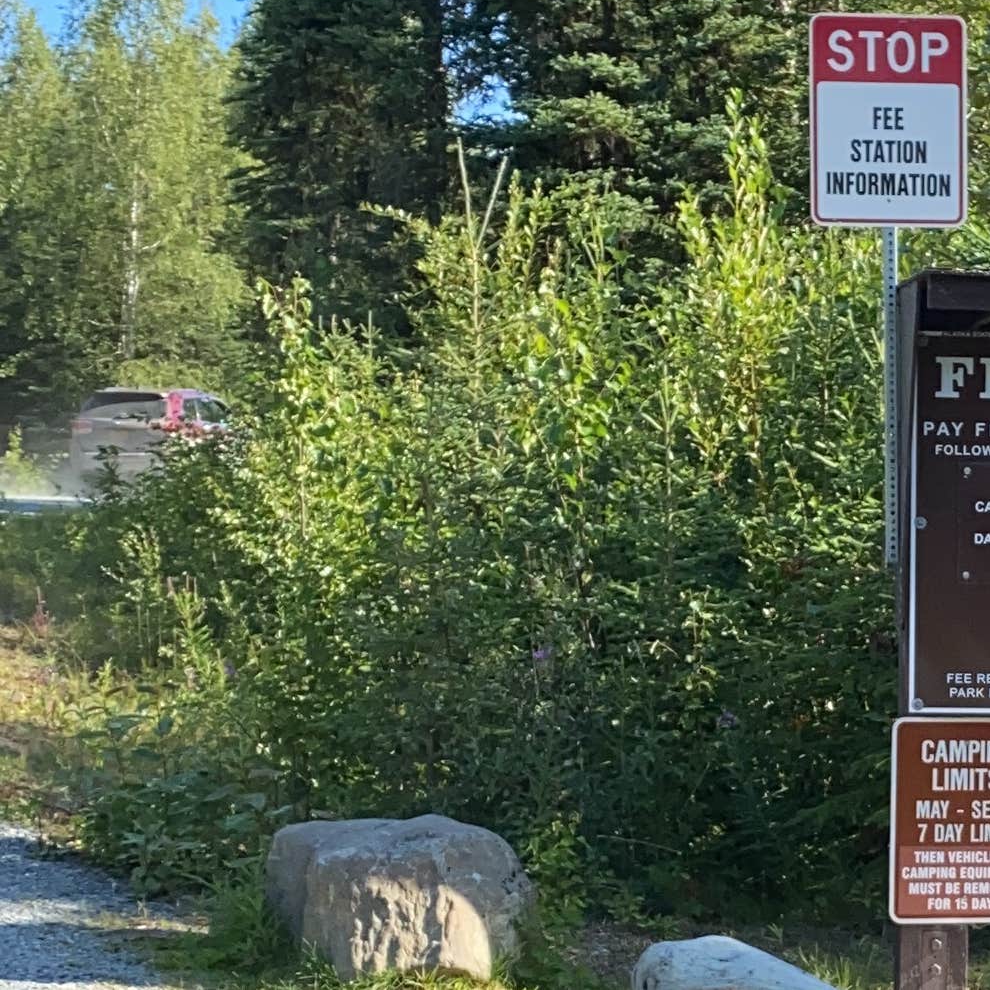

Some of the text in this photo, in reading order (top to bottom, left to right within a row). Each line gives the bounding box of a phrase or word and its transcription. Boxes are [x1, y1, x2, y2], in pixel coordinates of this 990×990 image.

[826, 29, 950, 73] STOP
[872, 107, 904, 130] FEE
[850, 139, 928, 163] STATION
[826, 172, 952, 197] INFORMATION
[923, 421, 964, 436] PAY
[946, 673, 972, 684] FEE
[950, 687, 985, 699] PARK
[916, 800, 950, 819] MAY
[918, 824, 928, 843] 7
[934, 824, 964, 843] DAY
[914, 851, 945, 863] THEN
[902, 867, 956, 879] CAMPING
[909, 882, 942, 895] MUST
[946, 882, 960, 894] BE
[928, 898, 951, 910] FOR
[955, 898, 968, 910] 15
